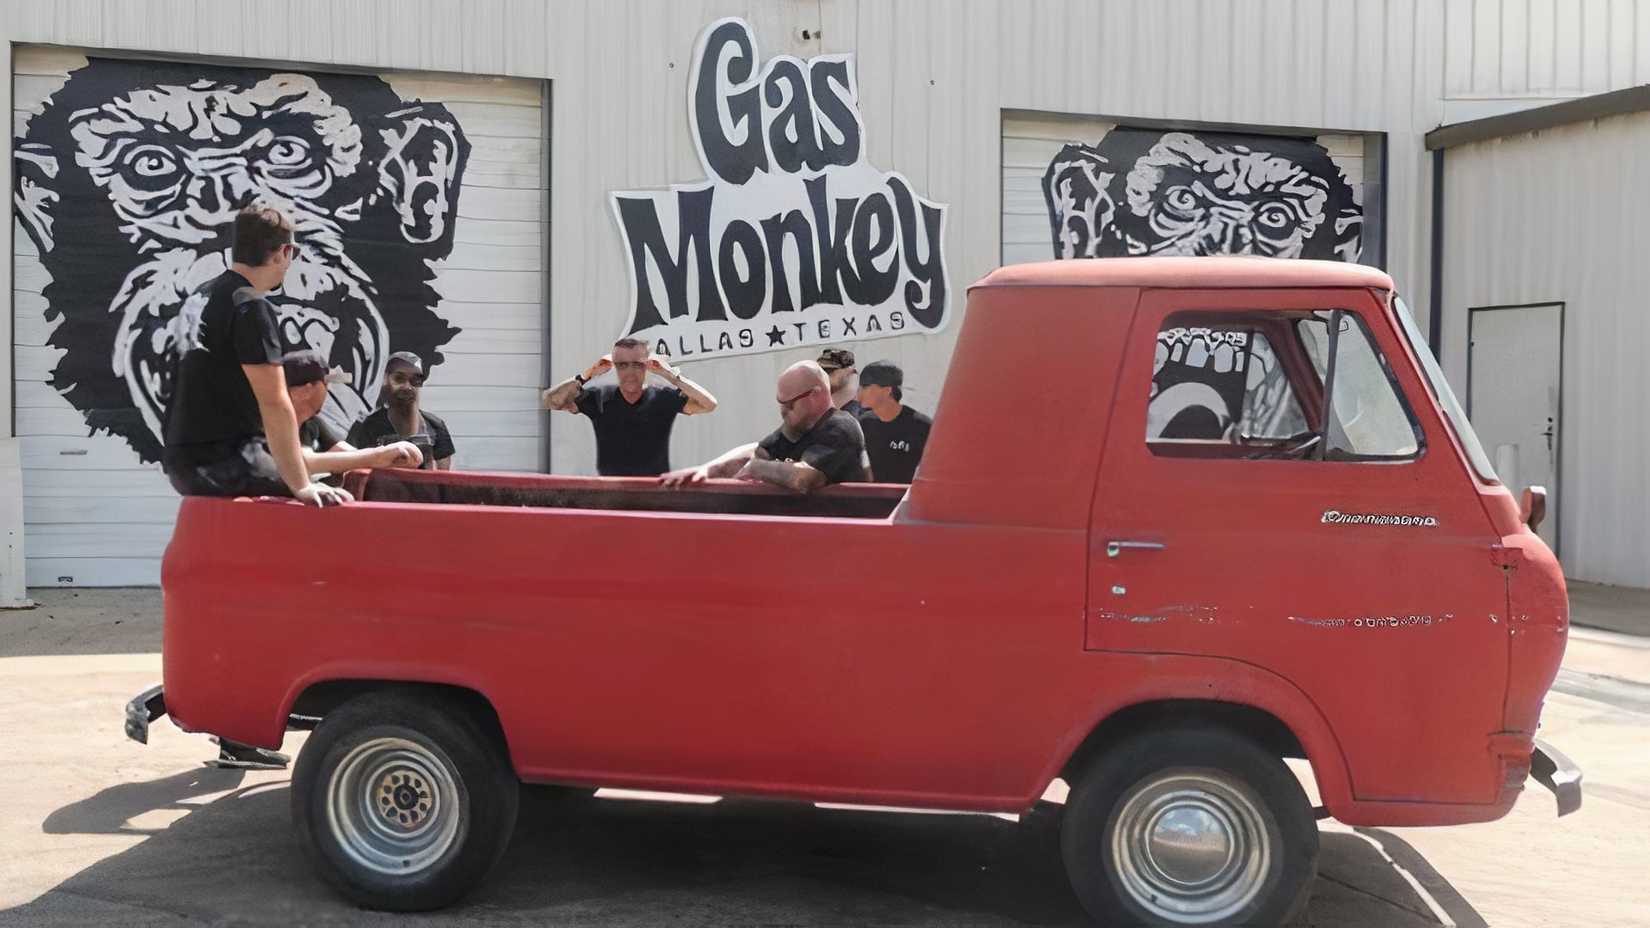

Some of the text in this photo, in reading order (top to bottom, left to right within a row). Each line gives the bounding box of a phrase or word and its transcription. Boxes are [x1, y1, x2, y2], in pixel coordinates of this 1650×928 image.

[695, 22, 861, 186] Gas
[615, 172, 946, 336] Monkey
[655, 311, 905, 357] ALLAS TEXAS
